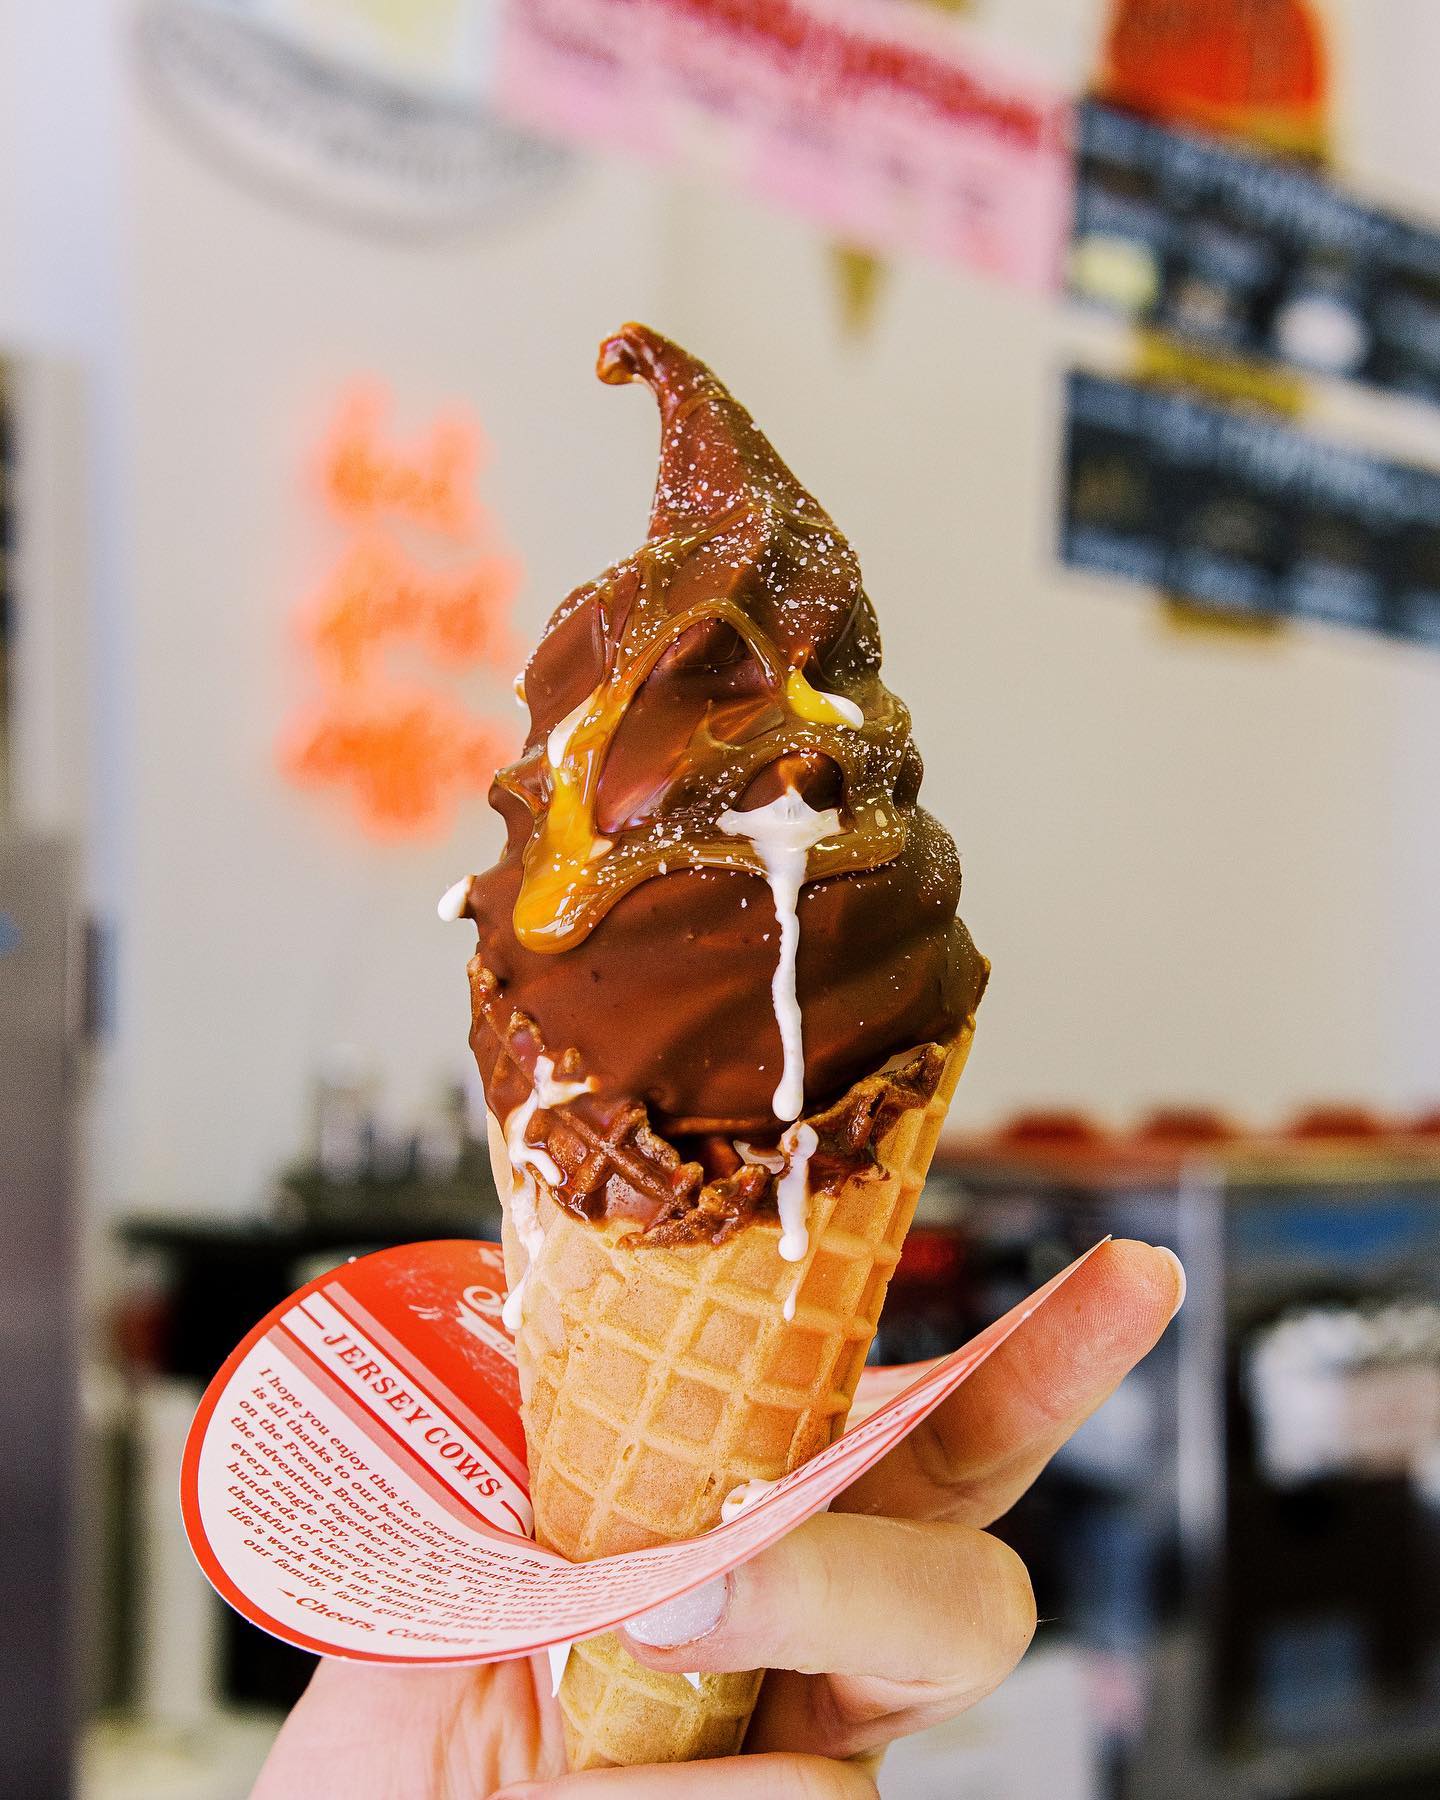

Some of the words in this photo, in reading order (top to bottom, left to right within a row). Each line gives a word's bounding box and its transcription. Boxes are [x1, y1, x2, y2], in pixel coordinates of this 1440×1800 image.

[239, 1400, 258, 1418] on
[259, 1418, 283, 1441] the
[282, 1441, 334, 1487] French
[332, 1487, 380, 1523] Broad
[376, 1522, 420, 1551] River.
[424, 1550, 450, 1563] My
[448, 1562, 513, 1582] parents
[251, 1387, 267, 1400] is
[266, 1400, 289, 1418] all
[286, 1419, 333, 1464] thanks
[334, 1465, 350, 1480] to
[351, 1481, 378, 1503] our
[378, 1502, 445, 1549] beautiful
[444, 1547, 496, 1568] Jersey
[499, 1566, 541, 1577] cows.
[260, 1368, 272, 1378] I
[268, 1377, 303, 1409] hope
[299, 1410, 330, 1436] you
[330, 1437, 369, 1472] enjoy
[369, 1473, 398, 1500] this
[397, 1500, 422, 1519] ice
[423, 1520, 469, 1548] cream
[472, 1546, 518, 1562] cone!
[520, 1558, 550, 1571] The
[323, 1333, 432, 1425] JERSEY
[424, 1427, 503, 1498] COWS
[227, 1462, 299, 1520] hundreds
[300, 1523, 324, 1536] of
[319, 1537, 374, 1568] Jersey
[376, 1569, 418, 1588] cows
[422, 1587, 460, 1600] with
[227, 1506, 266, 1535] life's
[267, 1536, 307, 1563] work
[308, 1562, 344, 1583] with
[345, 1583, 374, 1596] my
[376, 1595, 433, 1614] family.
[228, 1485, 294, 1535] thankful
[291, 1535, 309, 1547] to
[310, 1547, 349, 1571] have
[351, 1570, 379, 1585] the
[380, 1584, 480, 1612] opportunity
[231, 1416, 255, 1439] the
[254, 1441, 324, 1501] adventure
[325, 1502, 390, 1547] together
[389, 1547, 407, 1558] in
[409, 1557, 452, 1577] 1980.
[457, 1574, 488, 1586] For
[231, 1442, 273, 1477] every
[272, 1480, 317, 1516] single
[319, 1518, 349, 1542] day,
[355, 1542, 399, 1567] twice
[415, 1573, 449, 1588] day.
[244, 1539, 273, 1557] our
[272, 1558, 328, 1591] family,
[332, 1590, 373, 1609] farm
[372, 1607, 415, 1620] girls
